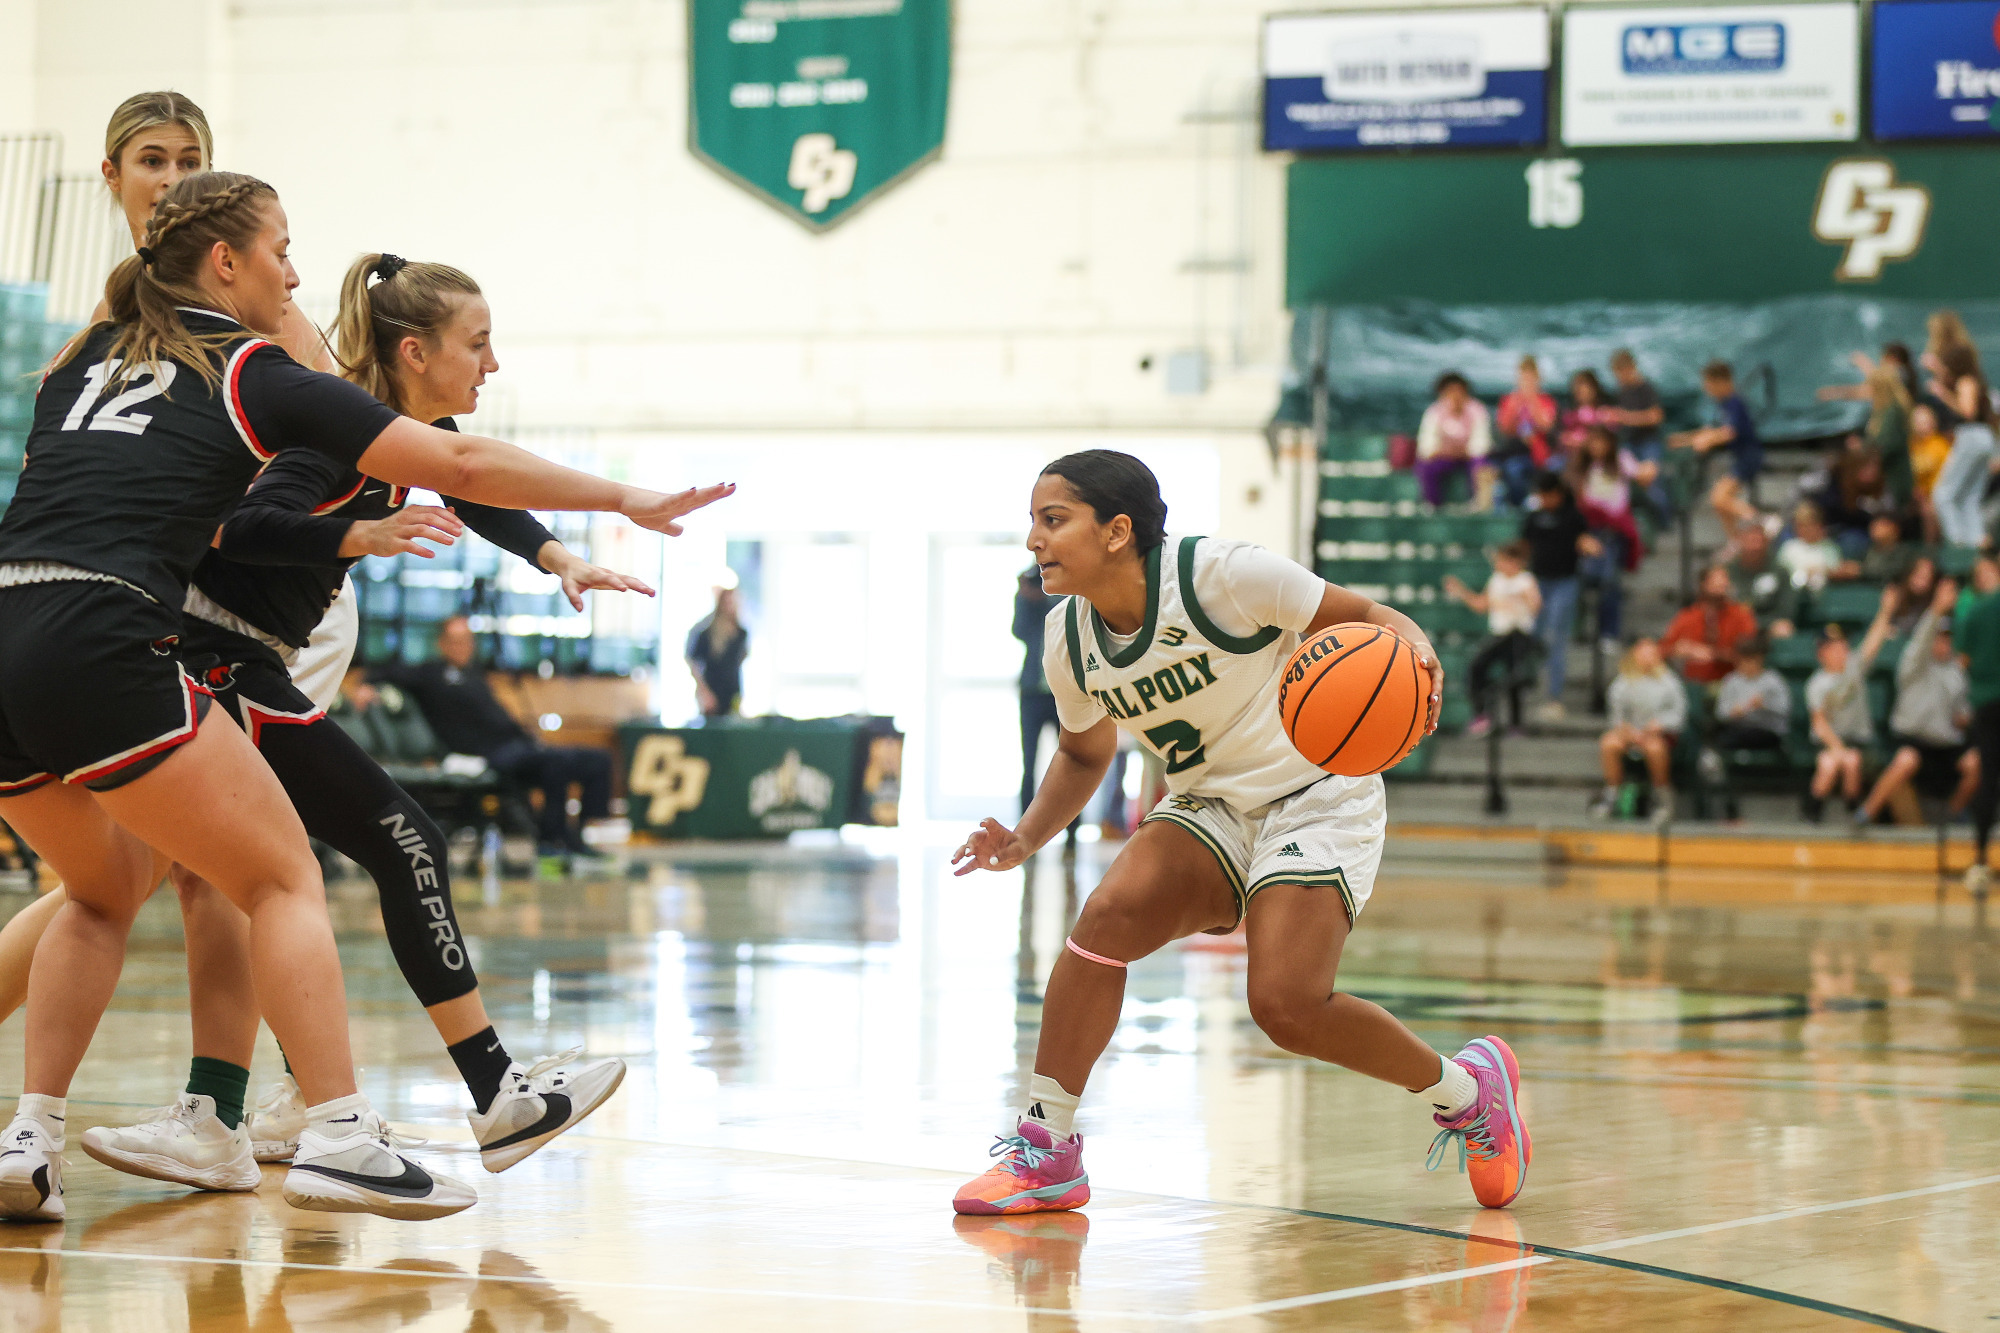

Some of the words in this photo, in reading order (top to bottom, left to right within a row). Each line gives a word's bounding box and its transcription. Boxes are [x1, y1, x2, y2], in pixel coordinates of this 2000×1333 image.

[1626, 26, 1780, 61] MGE
[1524, 159, 1584, 228] 15
[1812, 155, 1930, 282] CP
[61, 358, 177, 435] 12
[1131, 652, 1219, 716] POLY
[630, 735, 711, 826] CP
[1142, 719, 1206, 775] 2
[379, 813, 439, 892] NIKE
[420, 895, 465, 971] PRO
